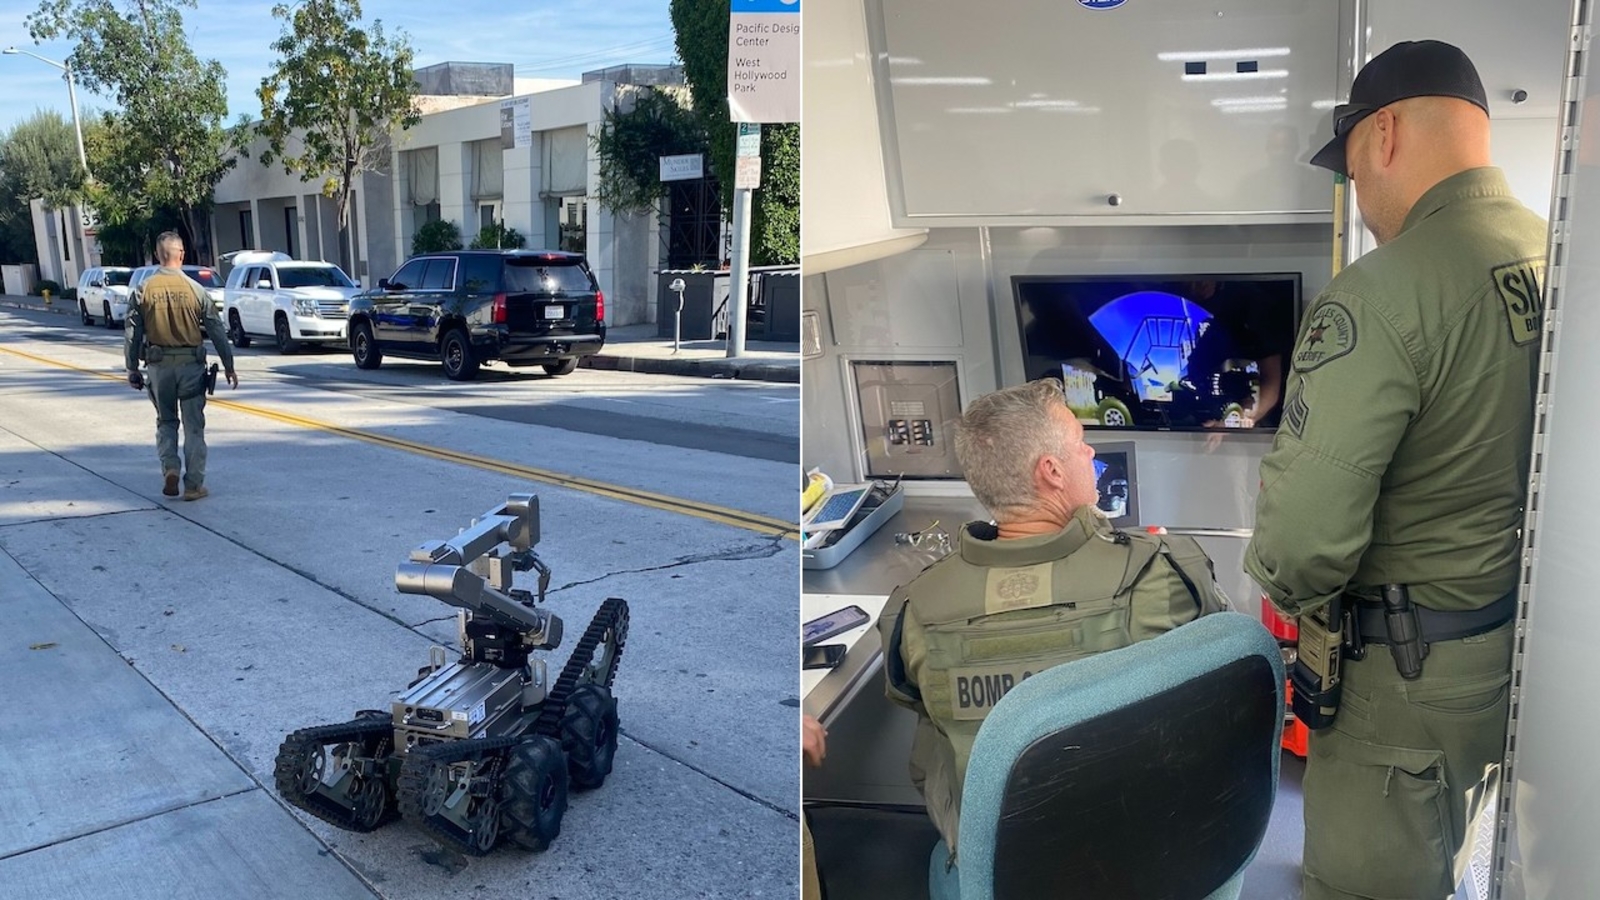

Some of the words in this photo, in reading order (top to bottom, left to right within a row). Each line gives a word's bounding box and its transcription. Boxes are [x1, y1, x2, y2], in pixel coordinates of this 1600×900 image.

[736, 23, 769, 33] Pacific
[772, 23, 800, 35] Desig
[736, 36, 769, 46] Center
[735, 58, 760, 67] West
[734, 70, 787, 81] Hollywood
[734, 83, 756, 92] Park
[741, 123, 747, 131] 2
[82, 214, 101, 226] 35
[1333, 314, 1349, 349] COUNTY
